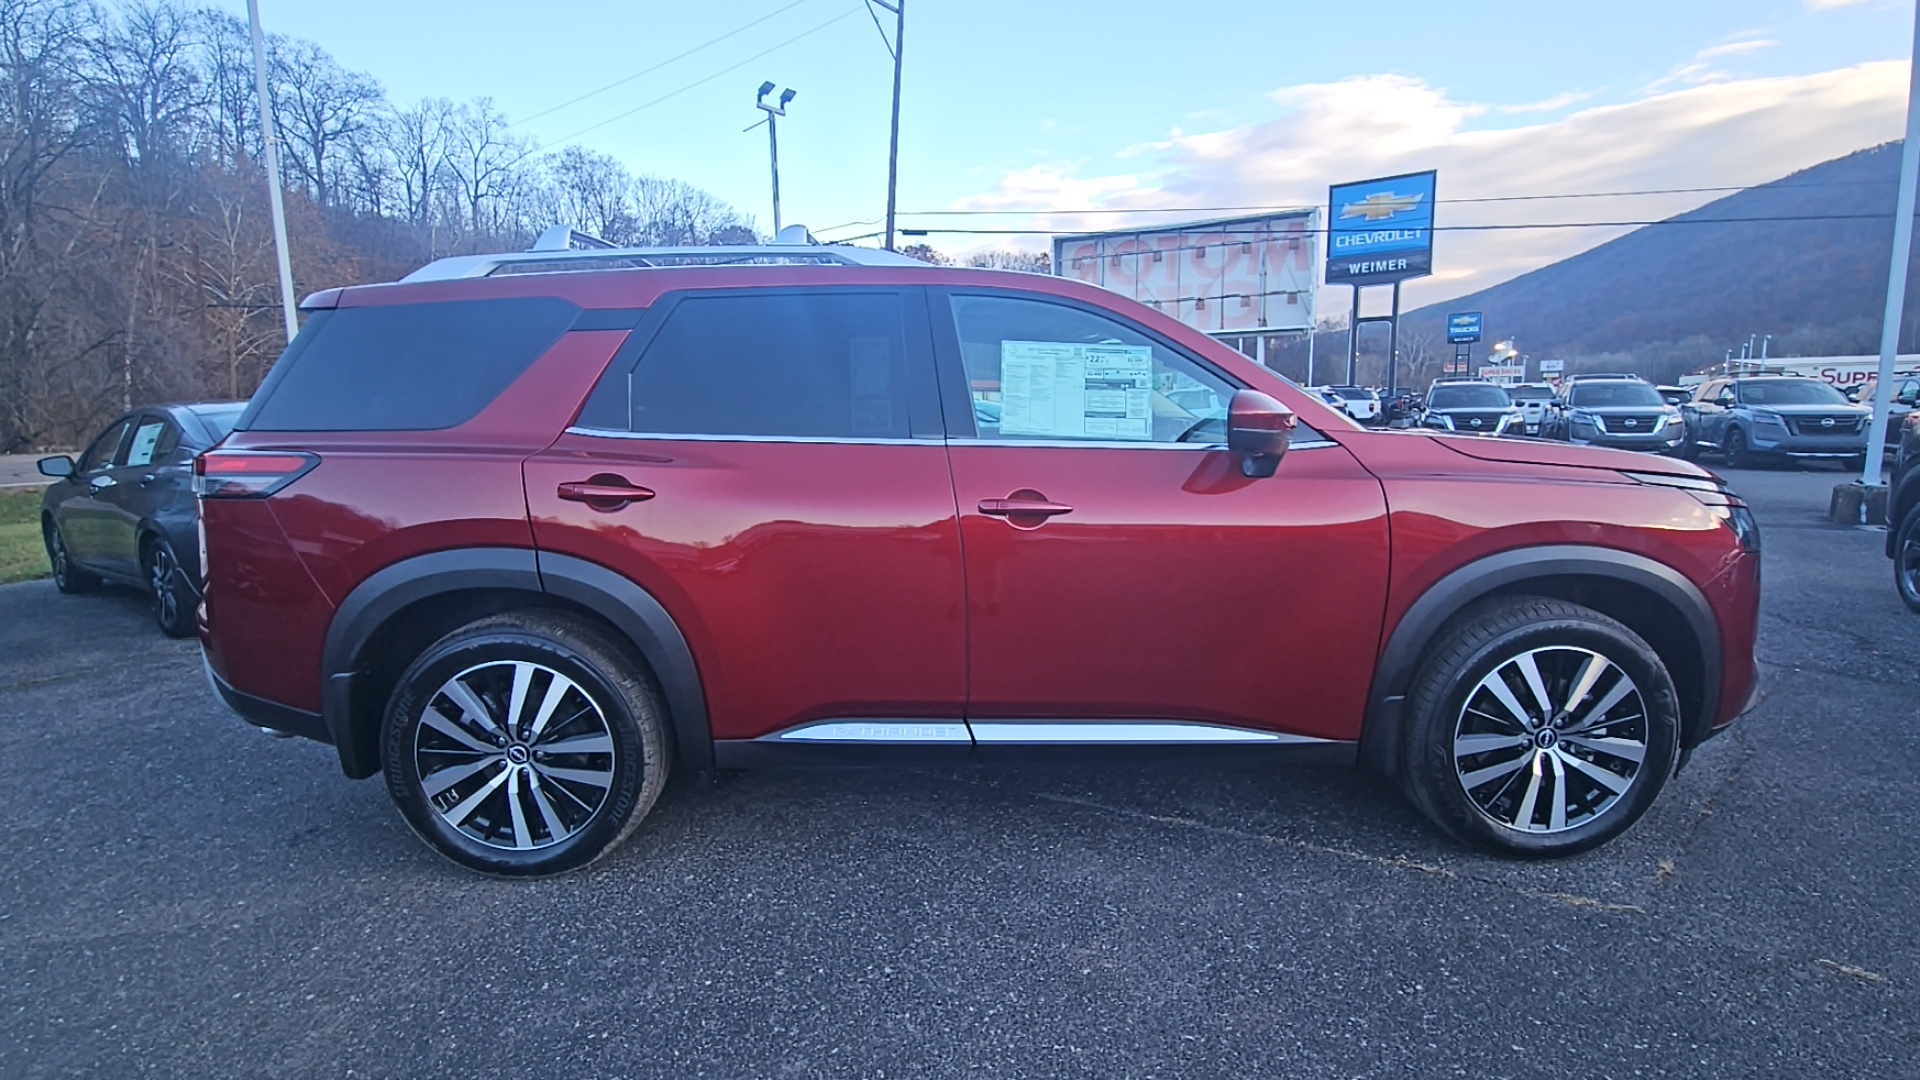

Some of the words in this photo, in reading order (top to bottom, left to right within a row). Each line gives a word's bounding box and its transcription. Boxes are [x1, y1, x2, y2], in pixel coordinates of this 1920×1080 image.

[1336, 226, 1423, 248] CHEVROLET
[1349, 259, 1407, 274] WEIMER
[1821, 367, 1879, 385] SUPE
